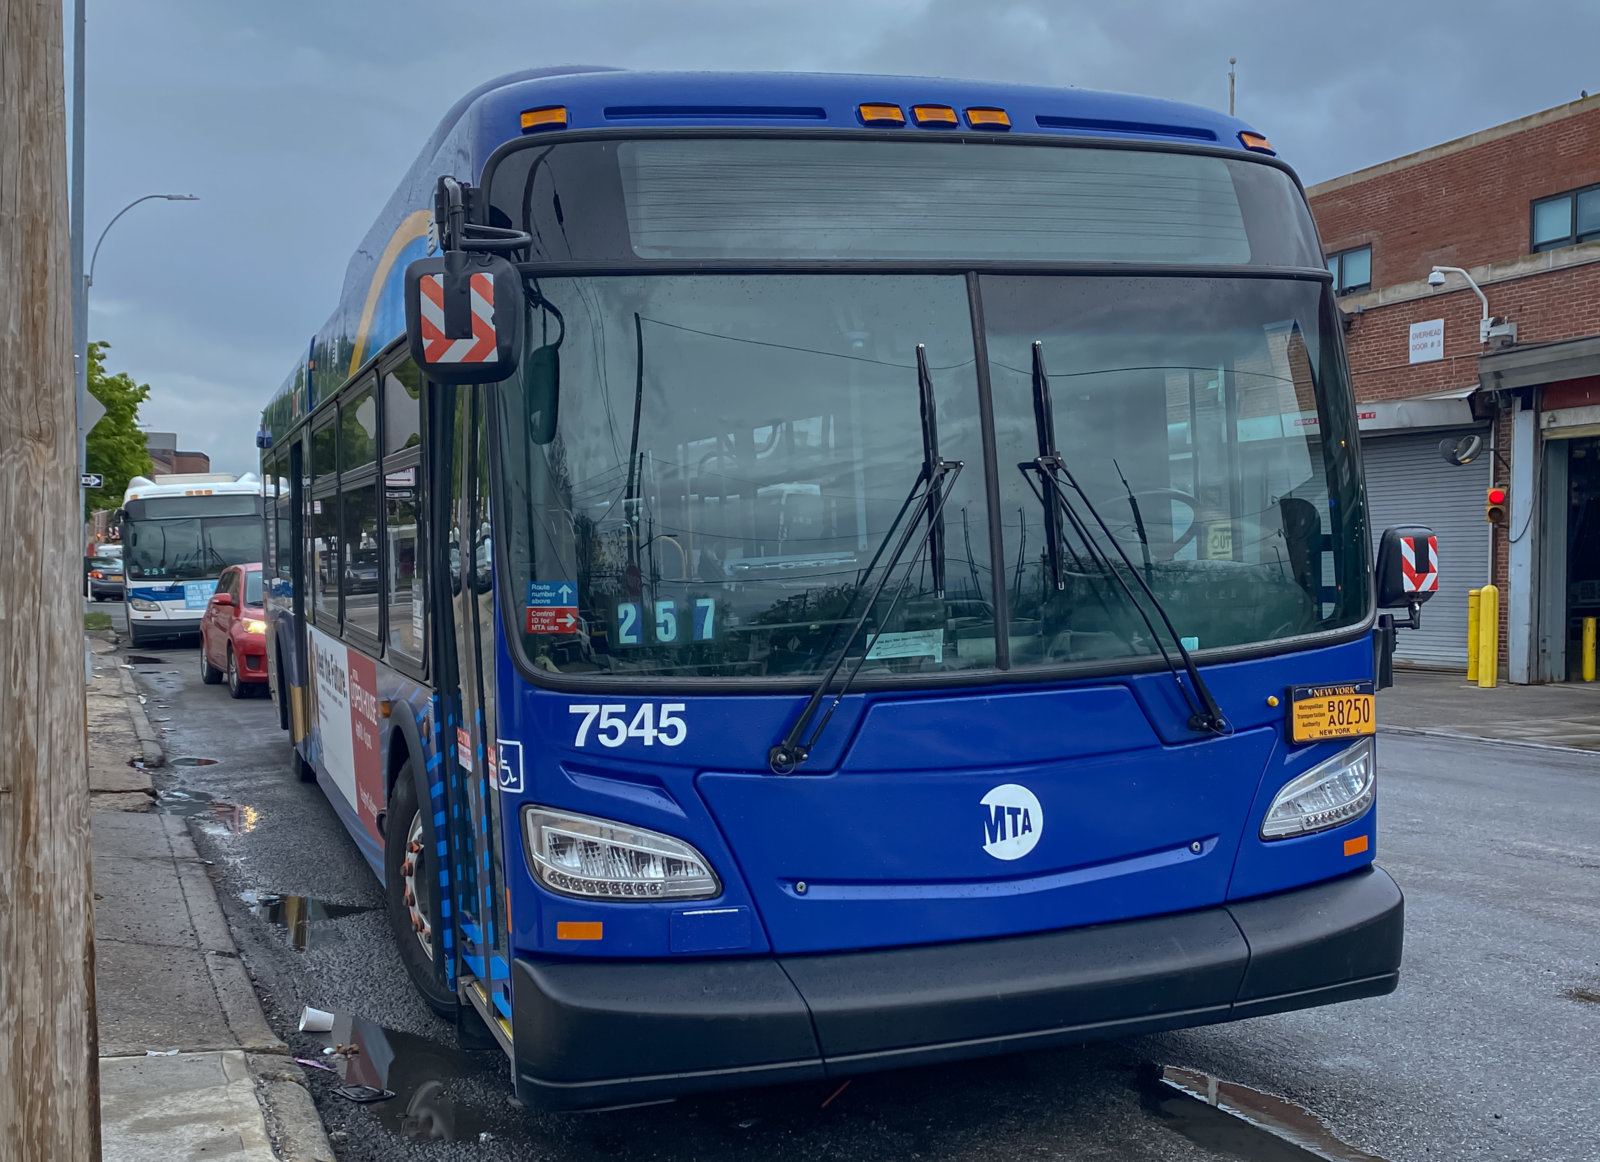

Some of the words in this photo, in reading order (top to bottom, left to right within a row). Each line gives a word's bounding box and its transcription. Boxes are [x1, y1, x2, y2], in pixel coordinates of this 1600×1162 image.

[1412, 329, 1441, 340] OVERHEAD
[1412, 343, 1428, 351] DOOR
[1313, 688, 1334, 697] NEW
[1334, 686, 1355, 695] YORK
[568, 703, 687, 747] 7545
[1335, 727, 1351, 735] YORK
[981, 803, 1033, 847] MTA
